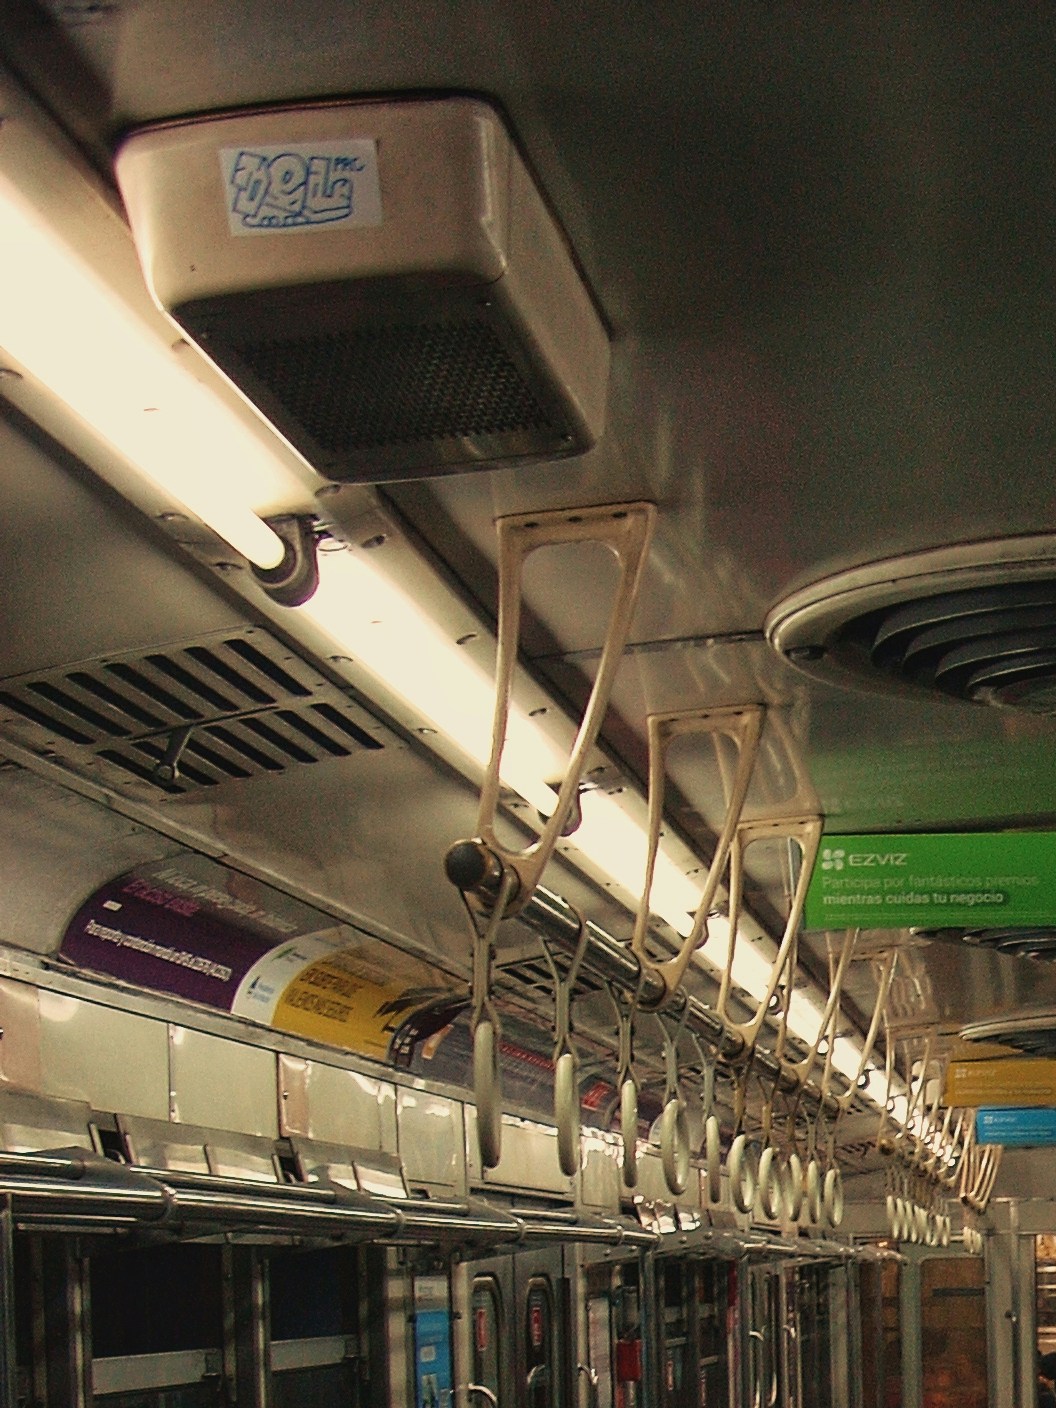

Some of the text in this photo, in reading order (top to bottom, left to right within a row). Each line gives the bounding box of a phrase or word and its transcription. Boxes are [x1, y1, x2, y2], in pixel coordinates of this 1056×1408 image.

[849, 853, 909, 866] EZVIZ
[822, 876, 881, 890] Participa
[883, 878, 904, 890] por
[823, 891, 1004, 906] mientras cuidas tu negocio
